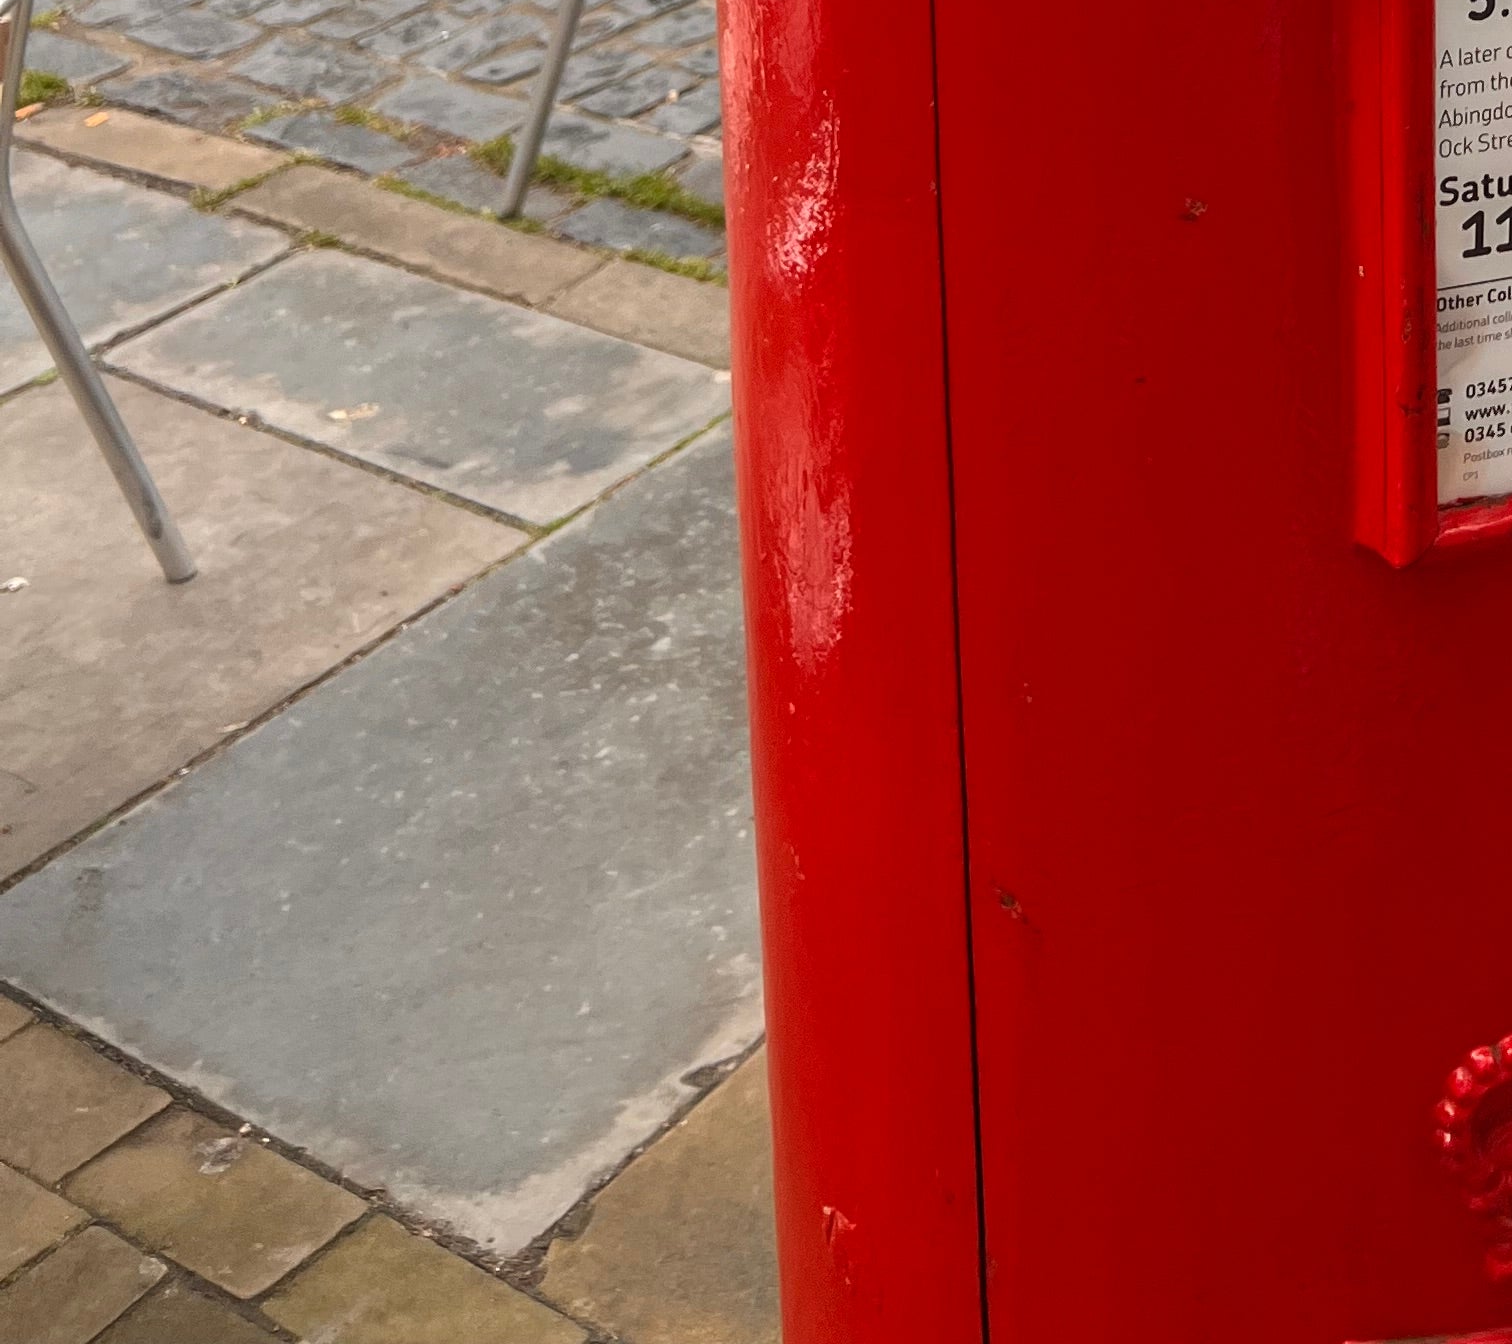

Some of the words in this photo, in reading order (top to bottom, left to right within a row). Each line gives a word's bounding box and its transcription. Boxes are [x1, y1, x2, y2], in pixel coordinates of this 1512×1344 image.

[1439, 50, 1454, 69] A
[1458, 44, 1501, 67] later
[1440, 78, 1485, 100] from
[1438, 138, 1473, 159] Ock
[1437, 293, 1484, 313] Other
[1437, 338, 1453, 352] he
[1454, 334, 1476, 350] last
[1477, 331, 1503, 345] time
[1464, 421, 1506, 444] 0345
[1463, 447, 1505, 465] Postbox
